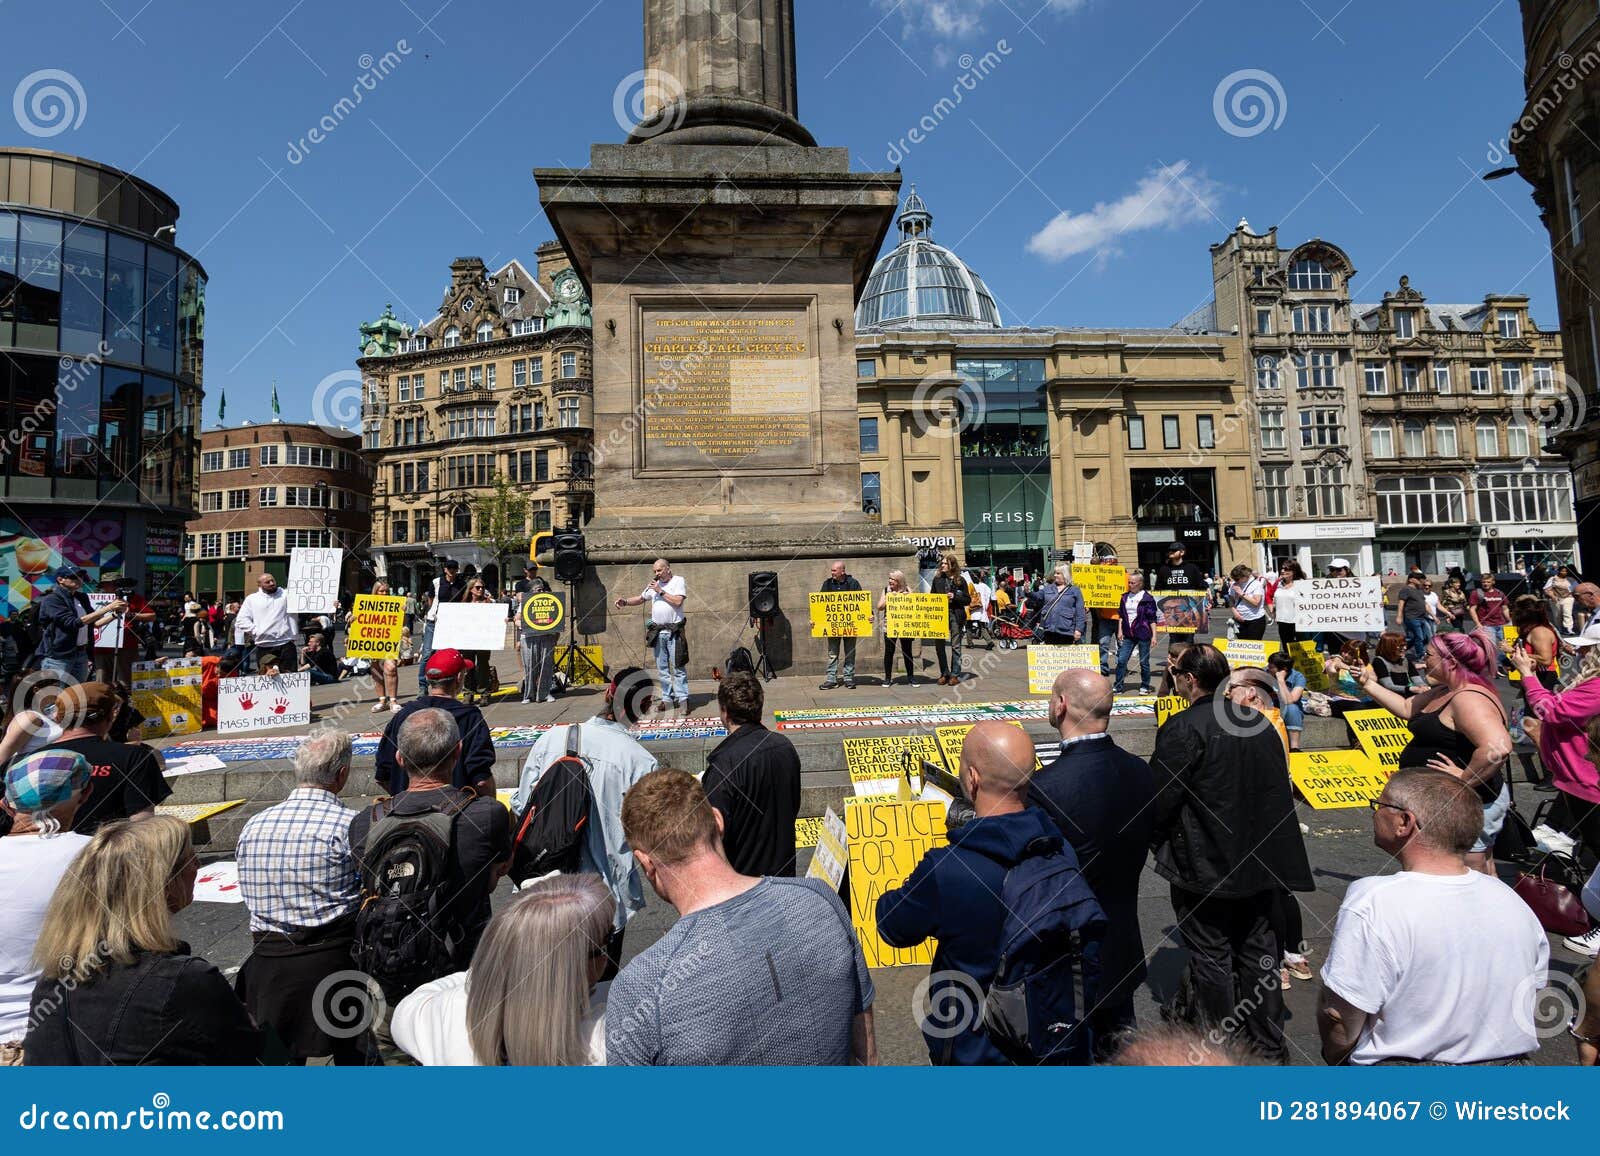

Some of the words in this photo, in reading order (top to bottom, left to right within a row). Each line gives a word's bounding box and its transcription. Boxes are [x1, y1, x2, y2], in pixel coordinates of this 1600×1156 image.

[645, 342, 703, 353] CHARLES
[708, 342, 745, 353] EARL
[746, 342, 782, 353] GREY
[1155, 476, 1185, 486] BOSS
[982, 511, 1035, 523] REISS
[1254, 528, 1262, 538] M
[1266, 528, 1276, 538] M
[902, 535, 955, 549] banyan
[296, 549, 335, 564] MEDIA
[302, 564, 330, 580] LIED
[1167, 576, 1189, 585] BEEB
[288, 580, 337, 595] PEOPLE
[810, 594, 836, 604] STAND
[837, 592, 870, 602] AGAINST
[887, 596, 912, 604] Injecting
[1310, 592, 1331, 600] TOO
[1333, 591, 1362, 599] MANY
[298, 595, 326, 611] DIED
[358, 600, 400, 613] SINISTER
[533, 599, 554, 607] STOP
[825, 603, 860, 613] AGENDA
[900, 604, 914, 612] Most
[916, 604, 944, 612] Dangerous
[1299, 603, 1339, 611] SUDDEN
[1341, 601, 1378, 609] ADULT
[357, 613, 398, 626] CLIMATE
[827, 613, 852, 622] 2030
[924, 613, 944, 621] History
[1317, 615, 1359, 624] DEATHS
[831, 621, 856, 629] BECOME
[904, 621, 930, 629] GENOCIDE
[360, 627, 391, 639] CRISIS
[832, 628, 858, 636] SLAVE
[348, 639, 399, 652] IDEOLOGY
[1228, 642, 1263, 650] DEMOCIDE
[218, 681, 275, 694] MIDAZOLAM
[1159, 699, 1172, 711] DO
[220, 718, 250, 730] MASS
[253, 712, 309, 726] MURDERER
[1354, 717, 1408, 731] SPIRITUAL
[939, 727, 967, 737] SPIKE
[844, 737, 890, 748] WHERE
[891, 737, 900, 746] U
[1371, 733, 1409, 748] BATTLE
[847, 747, 871, 757] BUY
[848, 753, 902, 766] BECAUSE
[1308, 754, 1328, 763] GO
[1308, 764, 1358, 776] GREEN
[1303, 775, 1371, 790] COMPOST
[1374, 775, 1385, 785] A
[847, 802, 947, 840] JUSTICE
[848, 839, 899, 877] FOR
